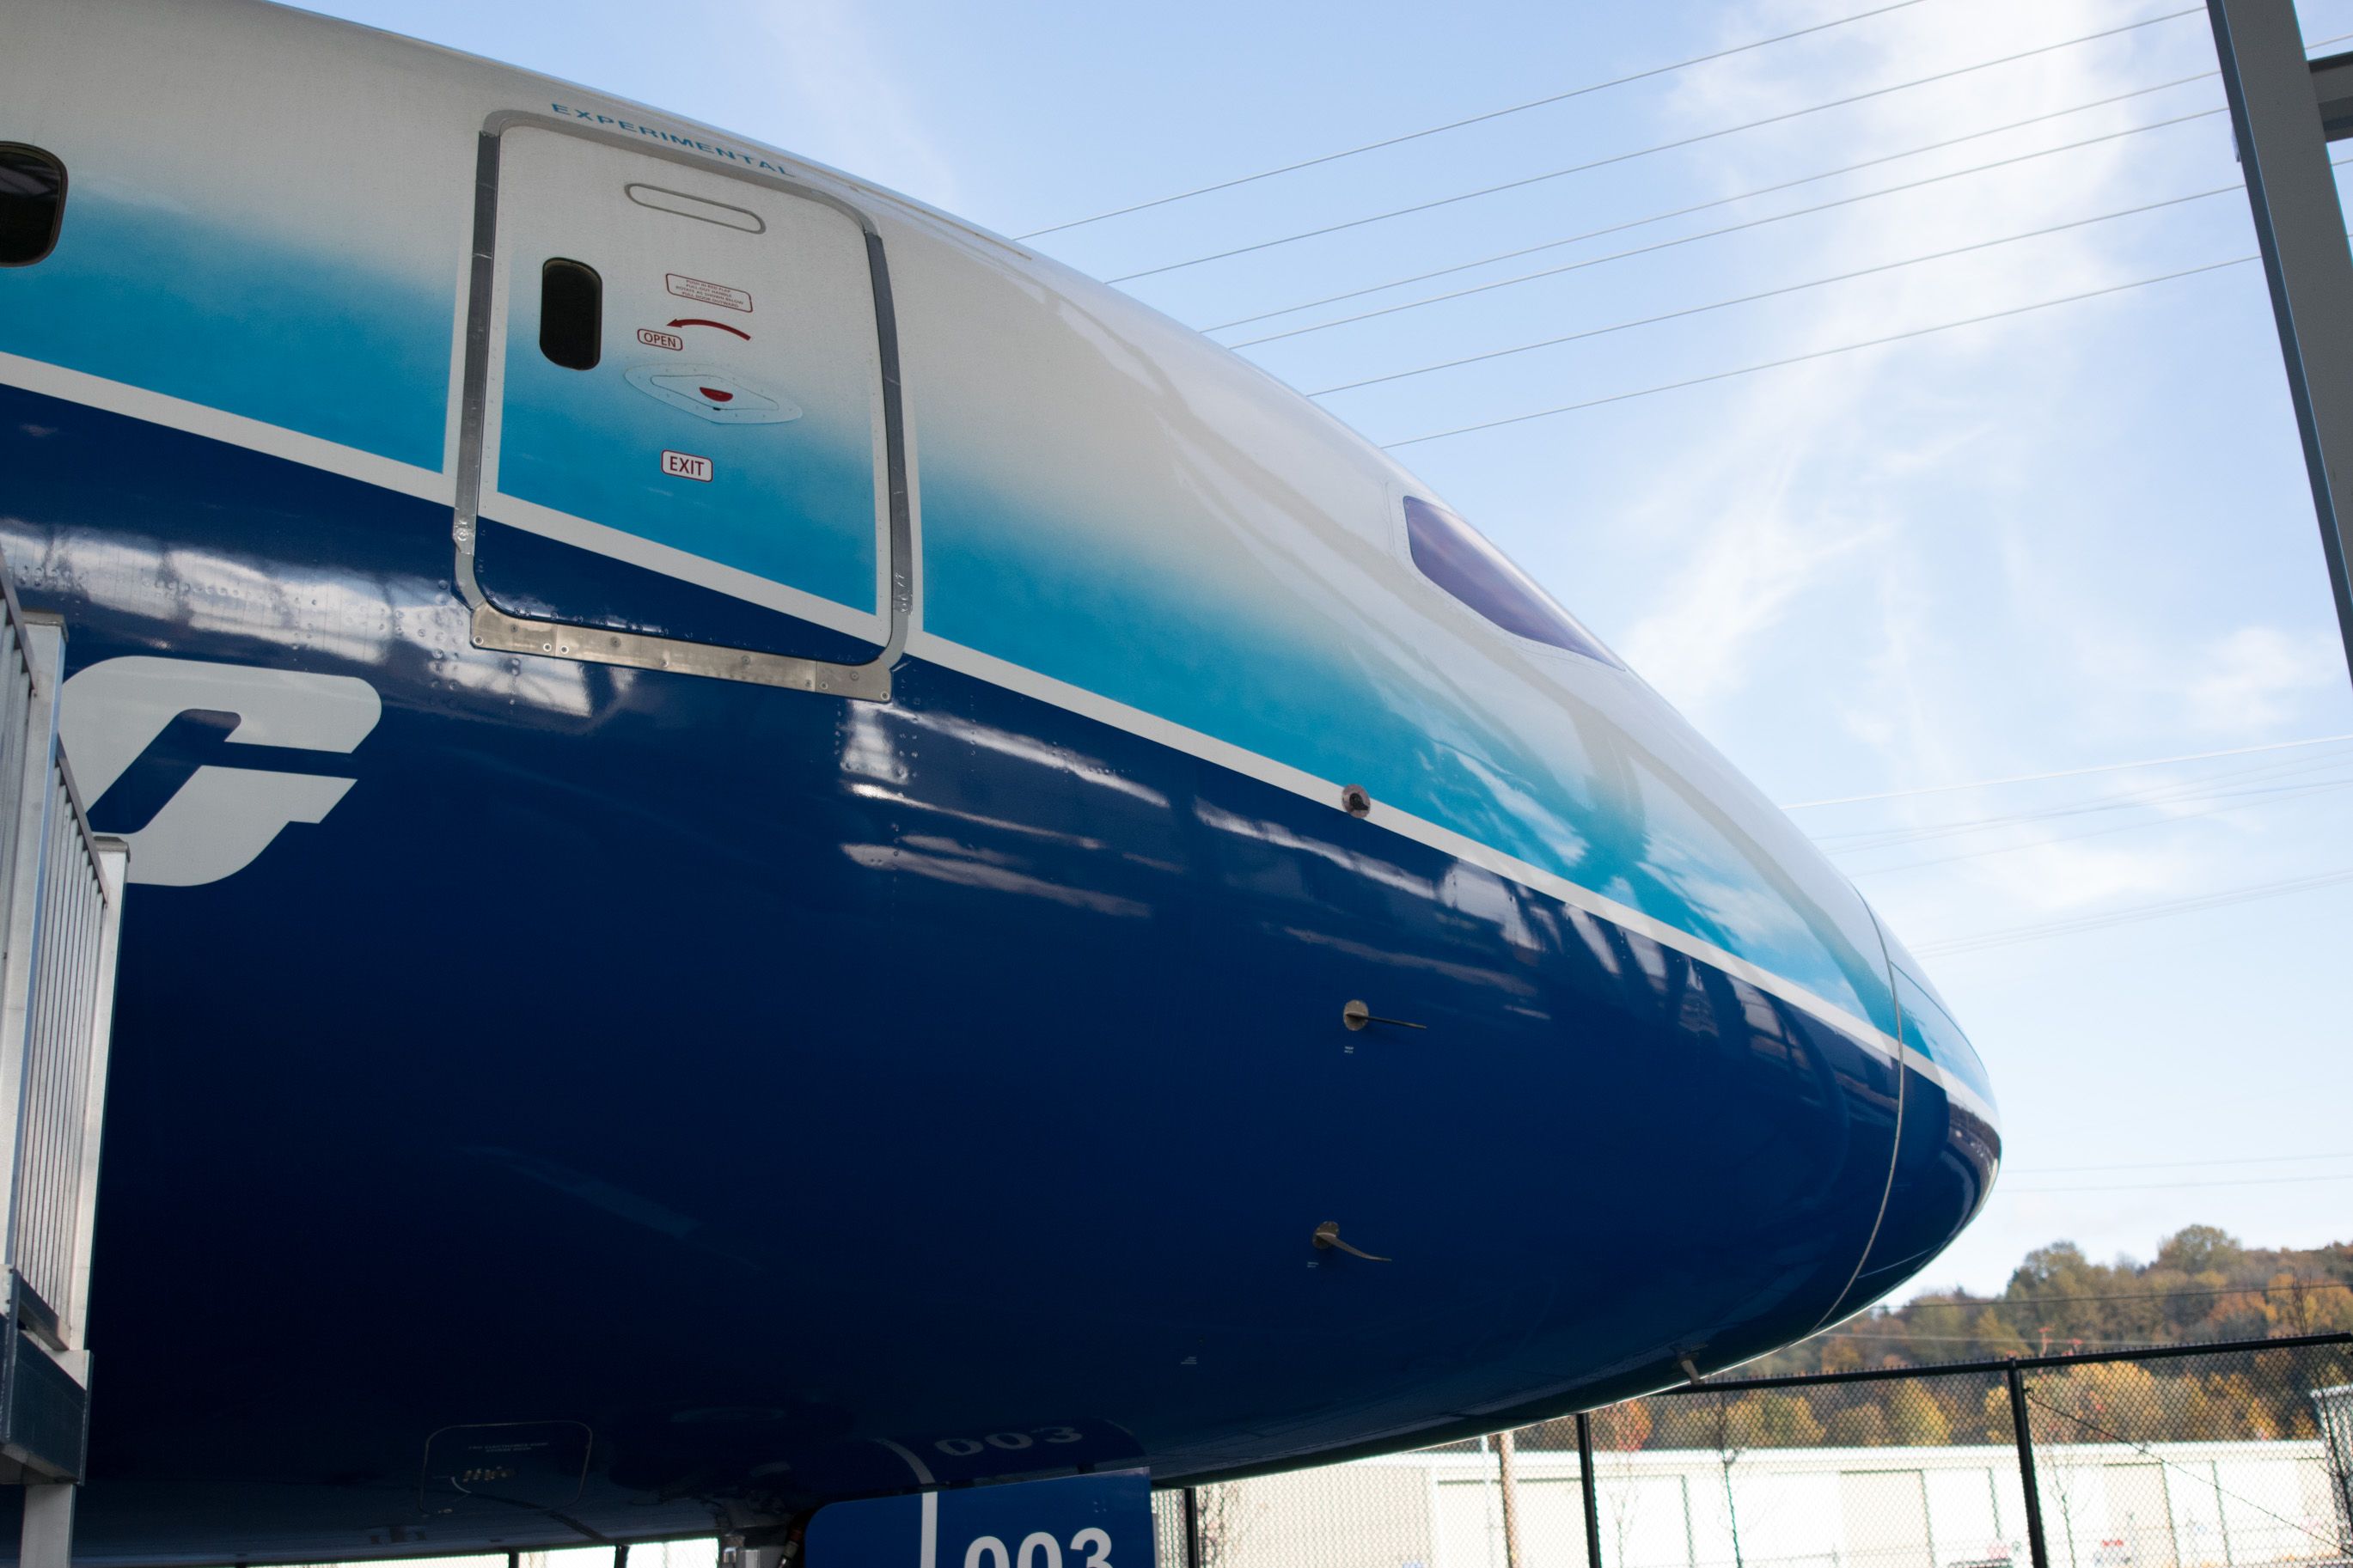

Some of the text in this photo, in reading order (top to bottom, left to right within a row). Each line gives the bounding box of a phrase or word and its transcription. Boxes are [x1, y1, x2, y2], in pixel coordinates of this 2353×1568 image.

[551, 103, 796, 178] EXPERIMENTAL
[644, 333, 676, 347] OPEN
[670, 455, 705, 476] EXIT
